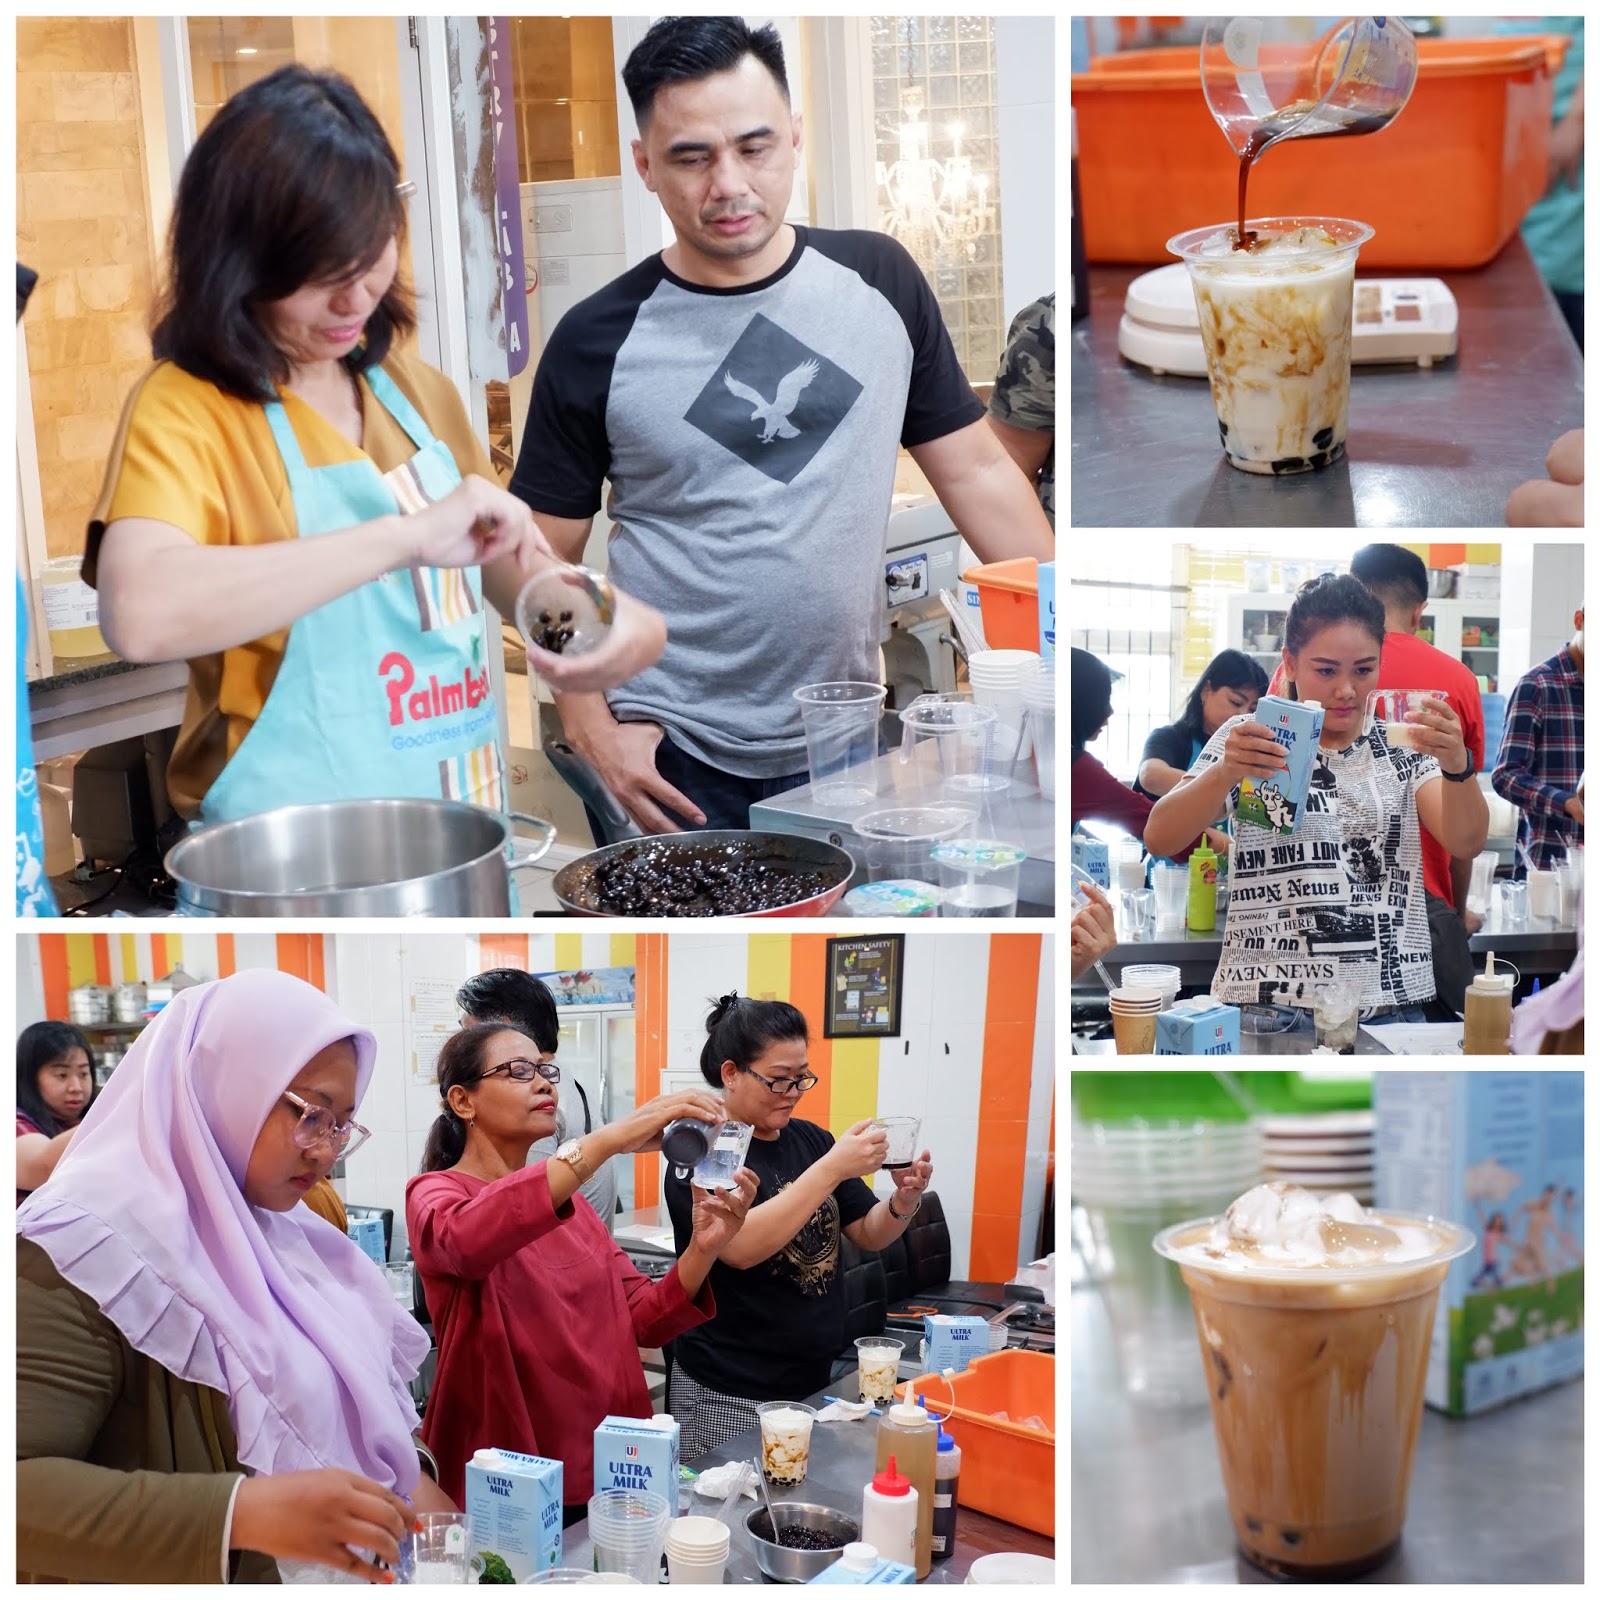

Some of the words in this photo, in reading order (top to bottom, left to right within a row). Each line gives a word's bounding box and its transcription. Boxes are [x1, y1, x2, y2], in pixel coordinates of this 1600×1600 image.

[391, 727, 461, 751] Goodness
[1287, 878, 1340, 898] News
[1350, 883, 1384, 893] FUNNY
[1351, 893, 1382, 903] NEWS
[1284, 916, 1316, 931] HERE
[838, 942, 868, 952] KITCHEN
[868, 941, 891, 949] SAFETY
[1378, 912, 1391, 991] BREAKING
[1275, 962, 1335, 979] NEWS
[609, 1461, 652, 1478] ULTRA
[486, 1475, 513, 1489] ULTRA
[613, 1475, 648, 1491] MILK
[489, 1484, 511, 1498] MILK
[541, 1499, 560, 1521] ULTRA
[543, 1511, 559, 1531] MILK
